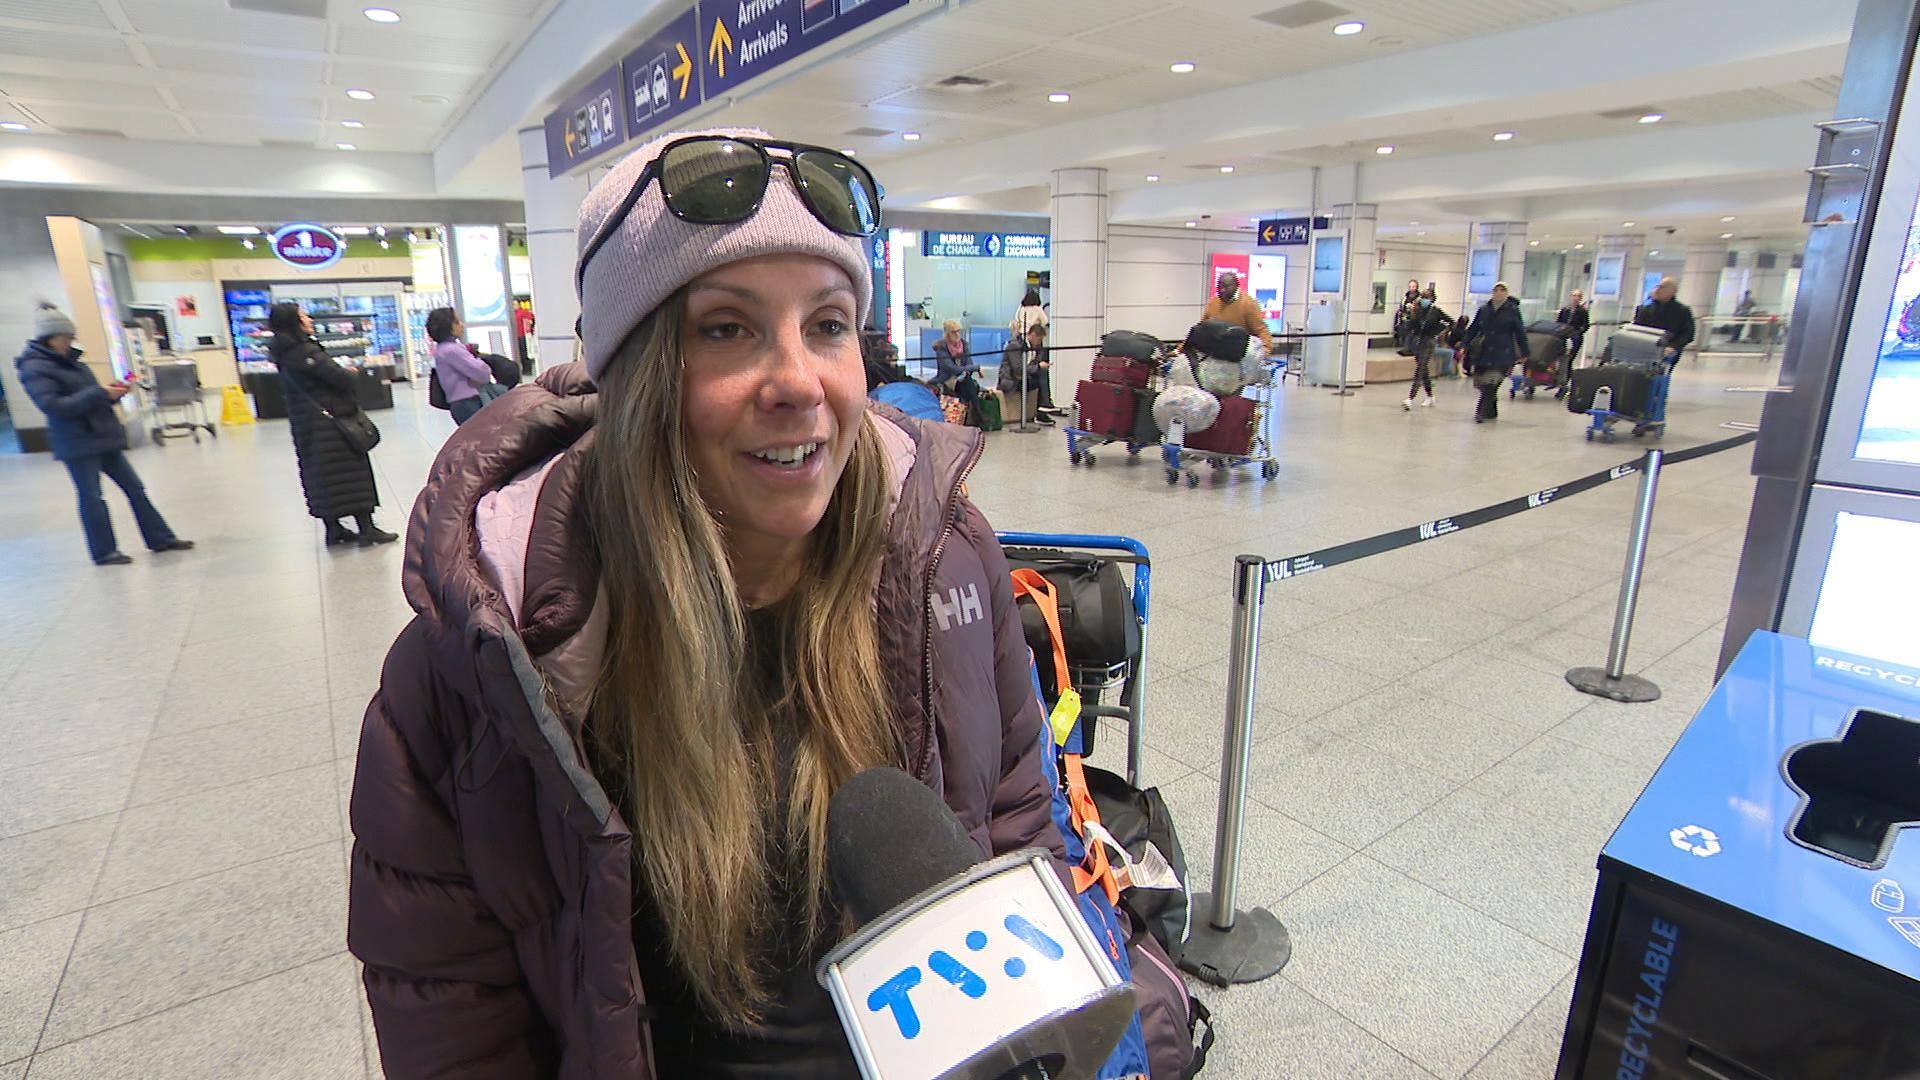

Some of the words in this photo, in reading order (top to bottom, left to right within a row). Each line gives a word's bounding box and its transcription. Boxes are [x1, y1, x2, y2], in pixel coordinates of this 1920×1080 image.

[738, 0, 787, 29] Arriv
[740, 20, 788, 67] Arrivals
[939, 233, 976, 245] BUREAU
[1004, 235, 1046, 246] CURRENCY
[932, 245, 945, 255] DE
[946, 245, 980, 255] CHANGE
[1004, 246, 1046, 256] EXCHANGE
[1420, 521, 1437, 540] YUL
[1267, 560, 1292, 581] YUL
[931, 583, 983, 631] HH
[1616, 917, 1679, 1080] RECYCLABLE
